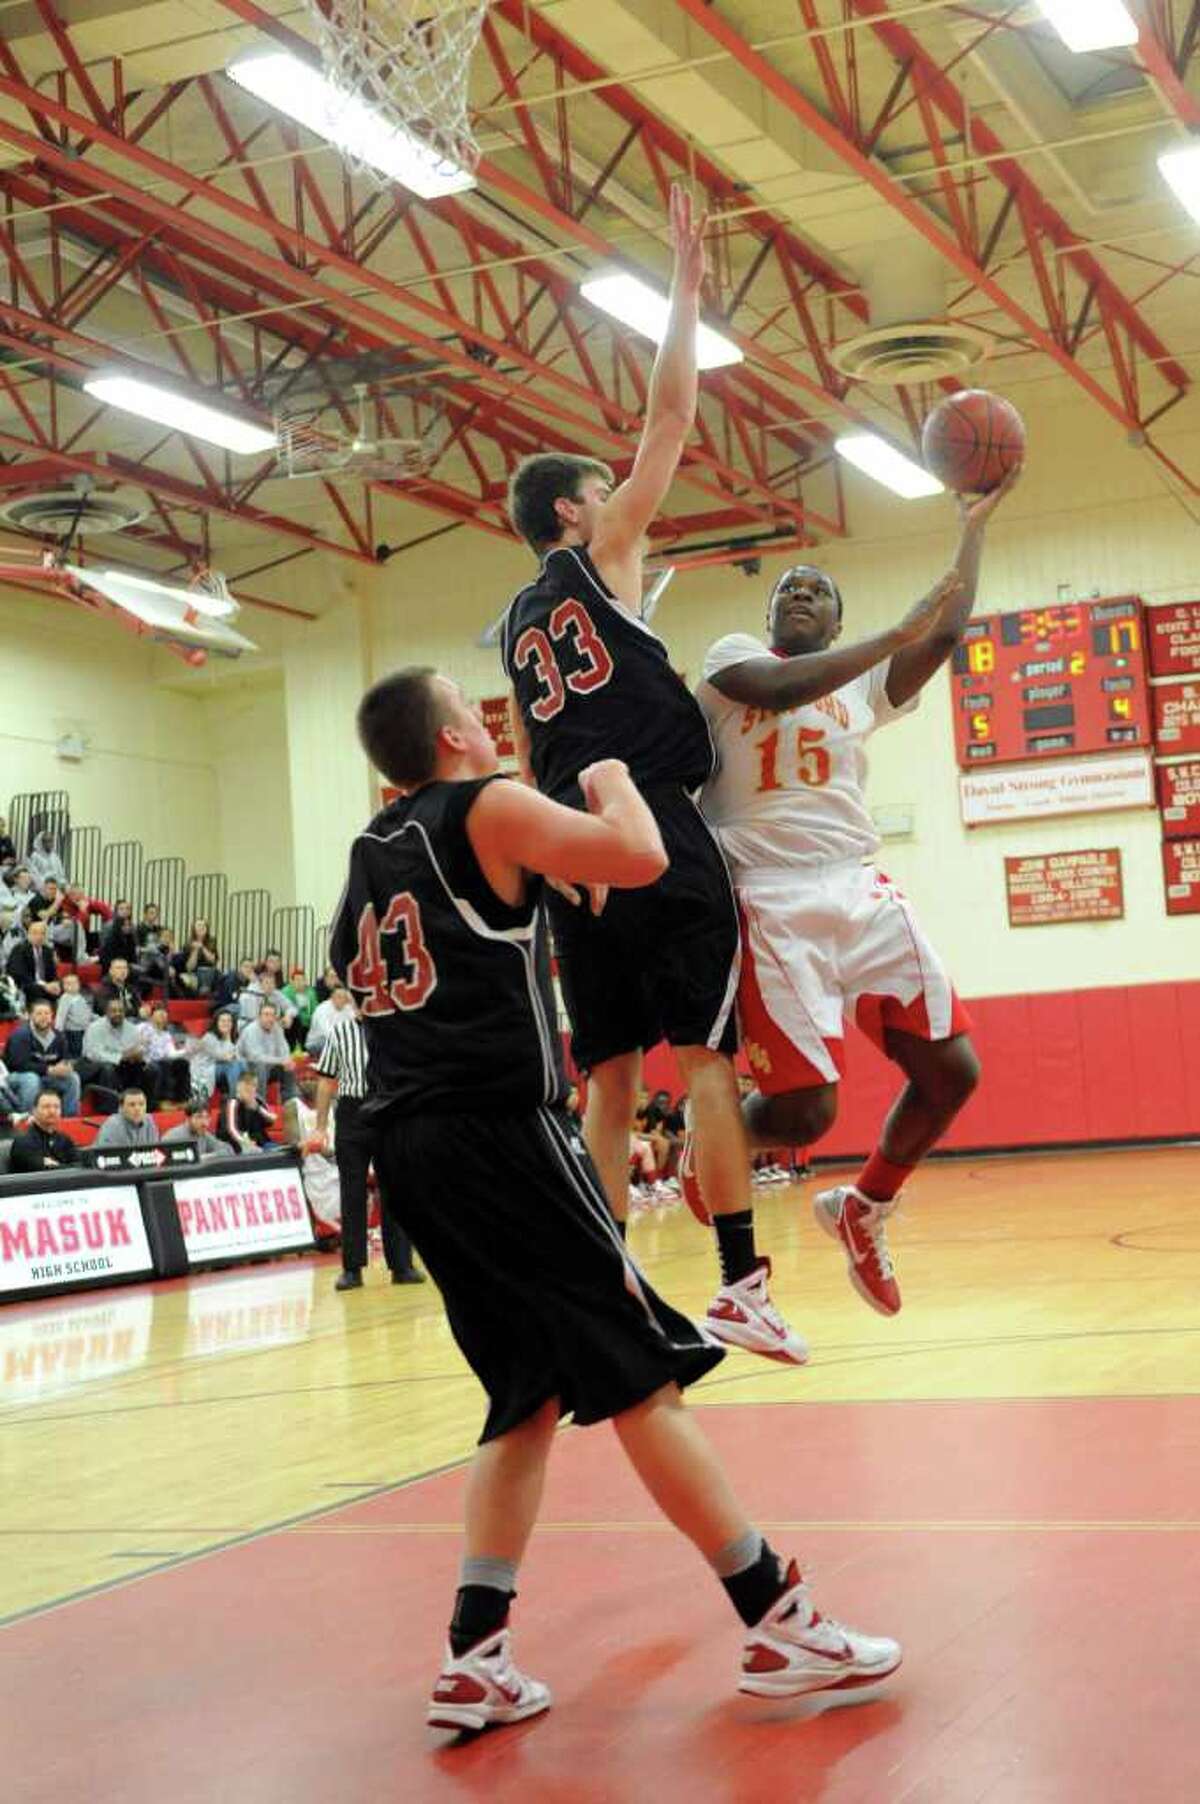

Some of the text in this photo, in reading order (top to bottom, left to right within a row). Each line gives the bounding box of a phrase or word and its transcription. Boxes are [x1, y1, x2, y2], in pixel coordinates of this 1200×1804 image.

[513, 597, 614, 721] 33
[1070, 649, 1086, 677] 2
[1112, 697, 1130, 720] 4
[756, 726, 831, 792] 15
[347, 890, 437, 1016] 43
[0, 1207, 132, 1262] MASUK
[178, 1185, 303, 1237] PANTHERS
[31, 1256, 113, 1280] HIGH SCHOOL
